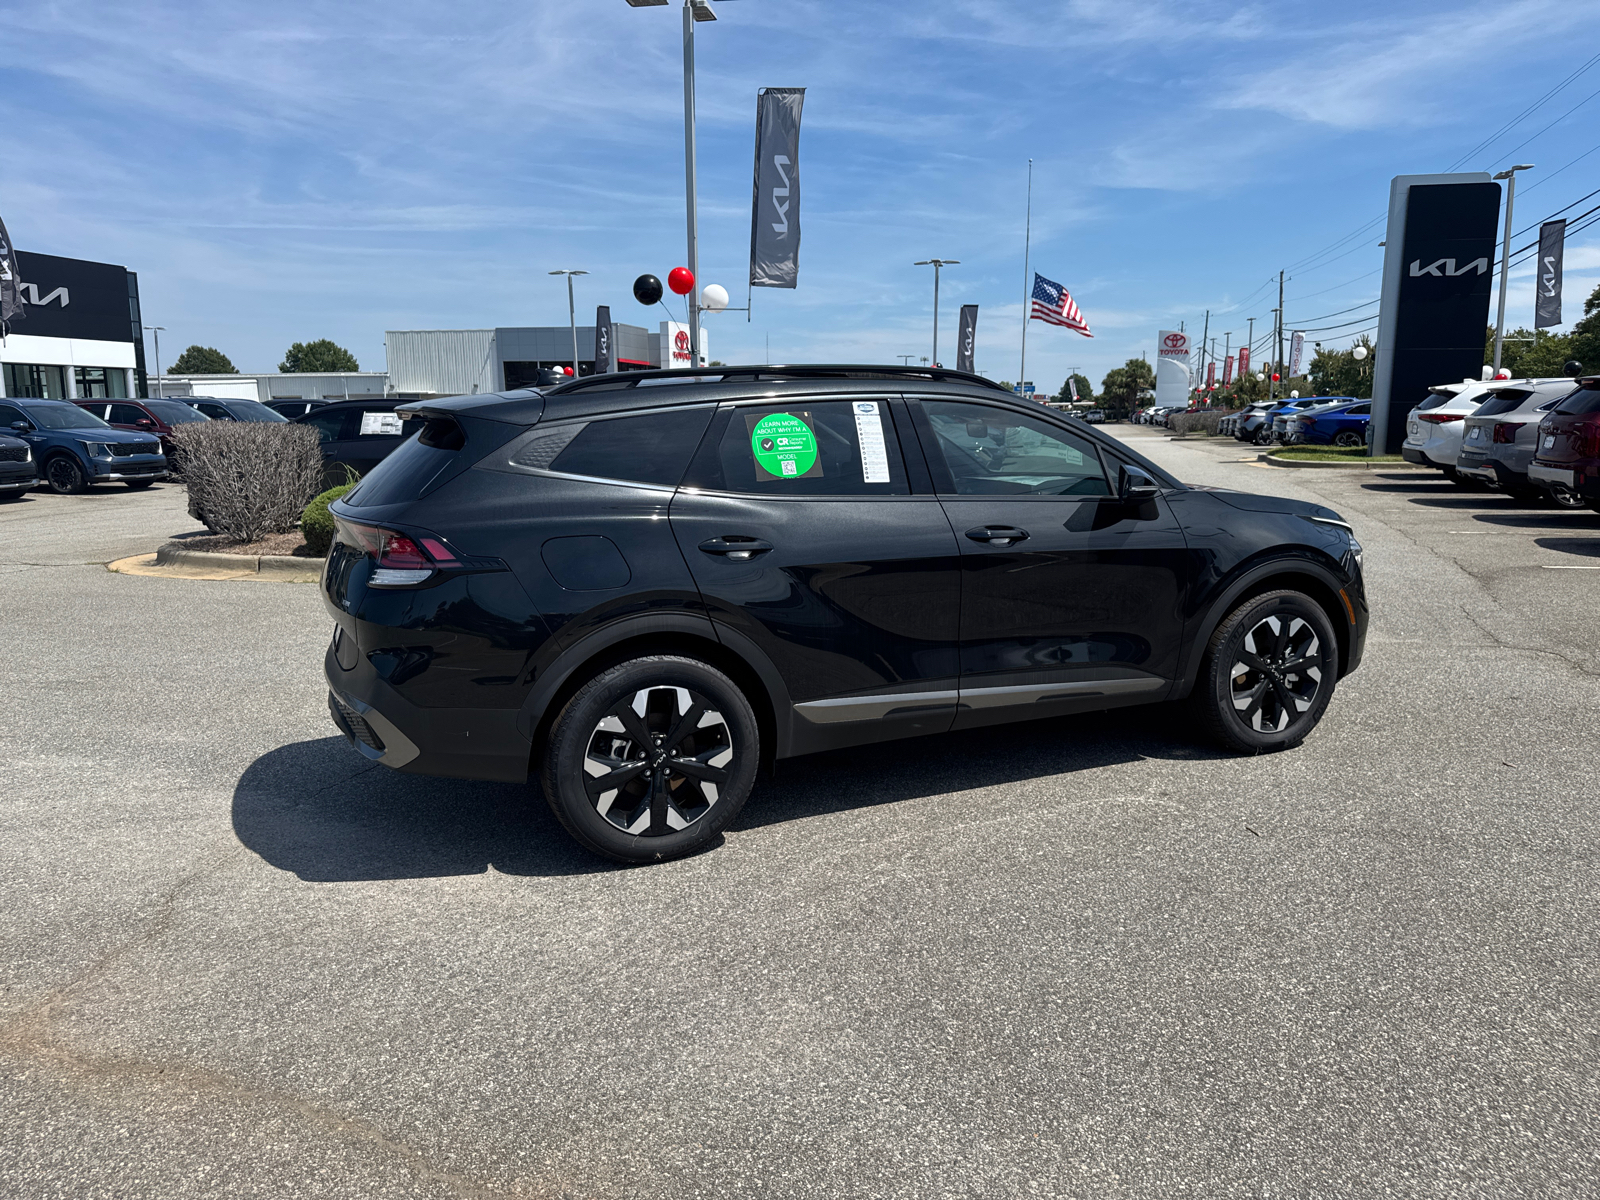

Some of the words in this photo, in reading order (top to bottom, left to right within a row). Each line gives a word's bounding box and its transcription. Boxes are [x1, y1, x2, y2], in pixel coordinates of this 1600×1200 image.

[771, 155, 791, 232] KIA
[1409, 257, 1489, 277] KIA
[1543, 256, 1556, 297] KIA
[777, 437, 789, 445] CR
